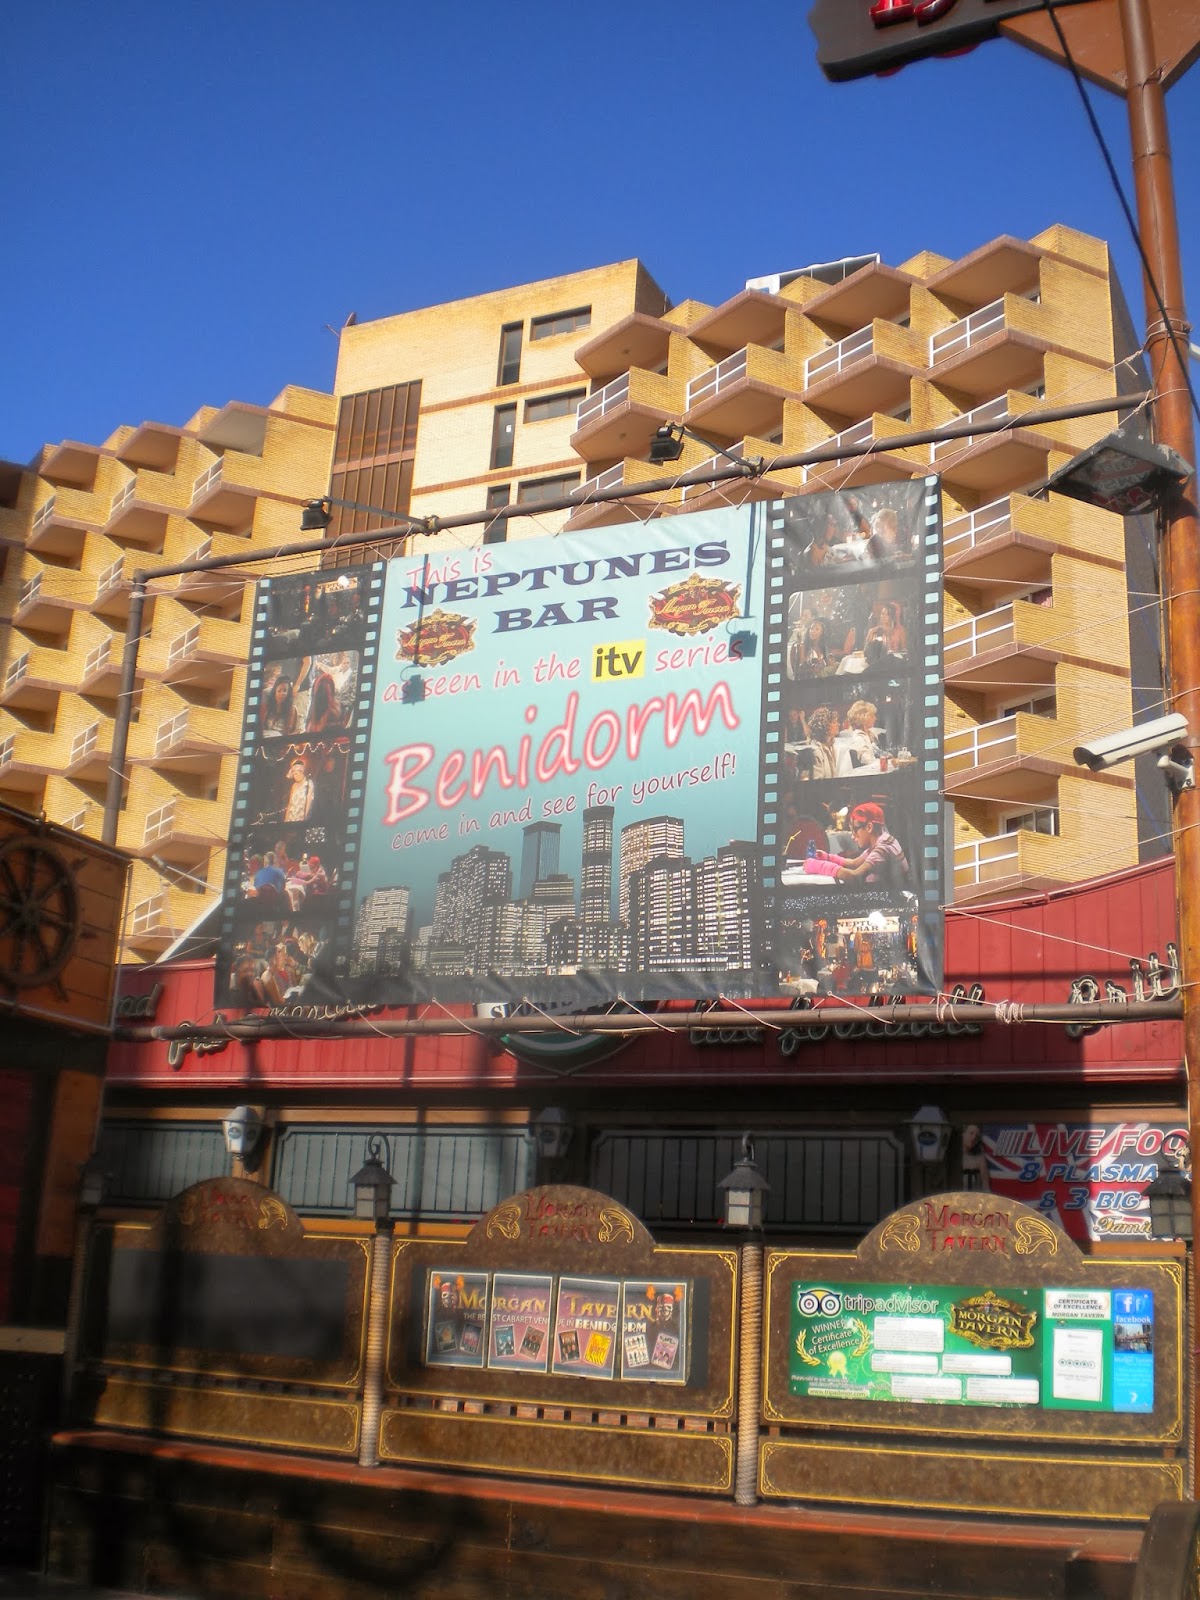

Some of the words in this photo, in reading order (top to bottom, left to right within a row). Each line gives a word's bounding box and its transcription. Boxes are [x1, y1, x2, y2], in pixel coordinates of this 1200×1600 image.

[400, 540, 731, 608] NEPTUNES
[405, 561, 462, 592] This
[473, 547, 494, 574] is
[491, 597, 620, 634] BAR
[421, 674, 482, 698] seen
[494, 661, 521, 688] in
[534, 653, 582, 683] the
[595, 647, 643, 678] itv
[656, 635, 745, 671] series
[383, 681, 740, 826] Benidorm
[391, 824, 450, 850] come
[458, 812, 482, 834] in
[488, 799, 532, 826] and
[542, 794, 578, 816] see
[587, 782, 624, 809] for
[631, 753, 737, 805] yourself!
[1020, 1130, 1104, 1156] LIVE
[1111, 1129, 1190, 1157] FOO
[1018, 1162, 1042, 1182] 8
[1046, 1163, 1159, 1183] PLASMA
[1064, 1187, 1089, 1210] 3
[1094, 1191, 1142, 1210] BIG
[844, 1294, 939, 1315] tripadvisor
[812, 1320, 846, 1334] WINNER
[958, 1308, 1024, 1328] MORGAN
[960, 1320, 1020, 1338] TAVERN
[809, 1346, 817, 1356] of
[818, 1338, 860, 1354] Excellence
[812, 1330, 853, 1346] Certificate
